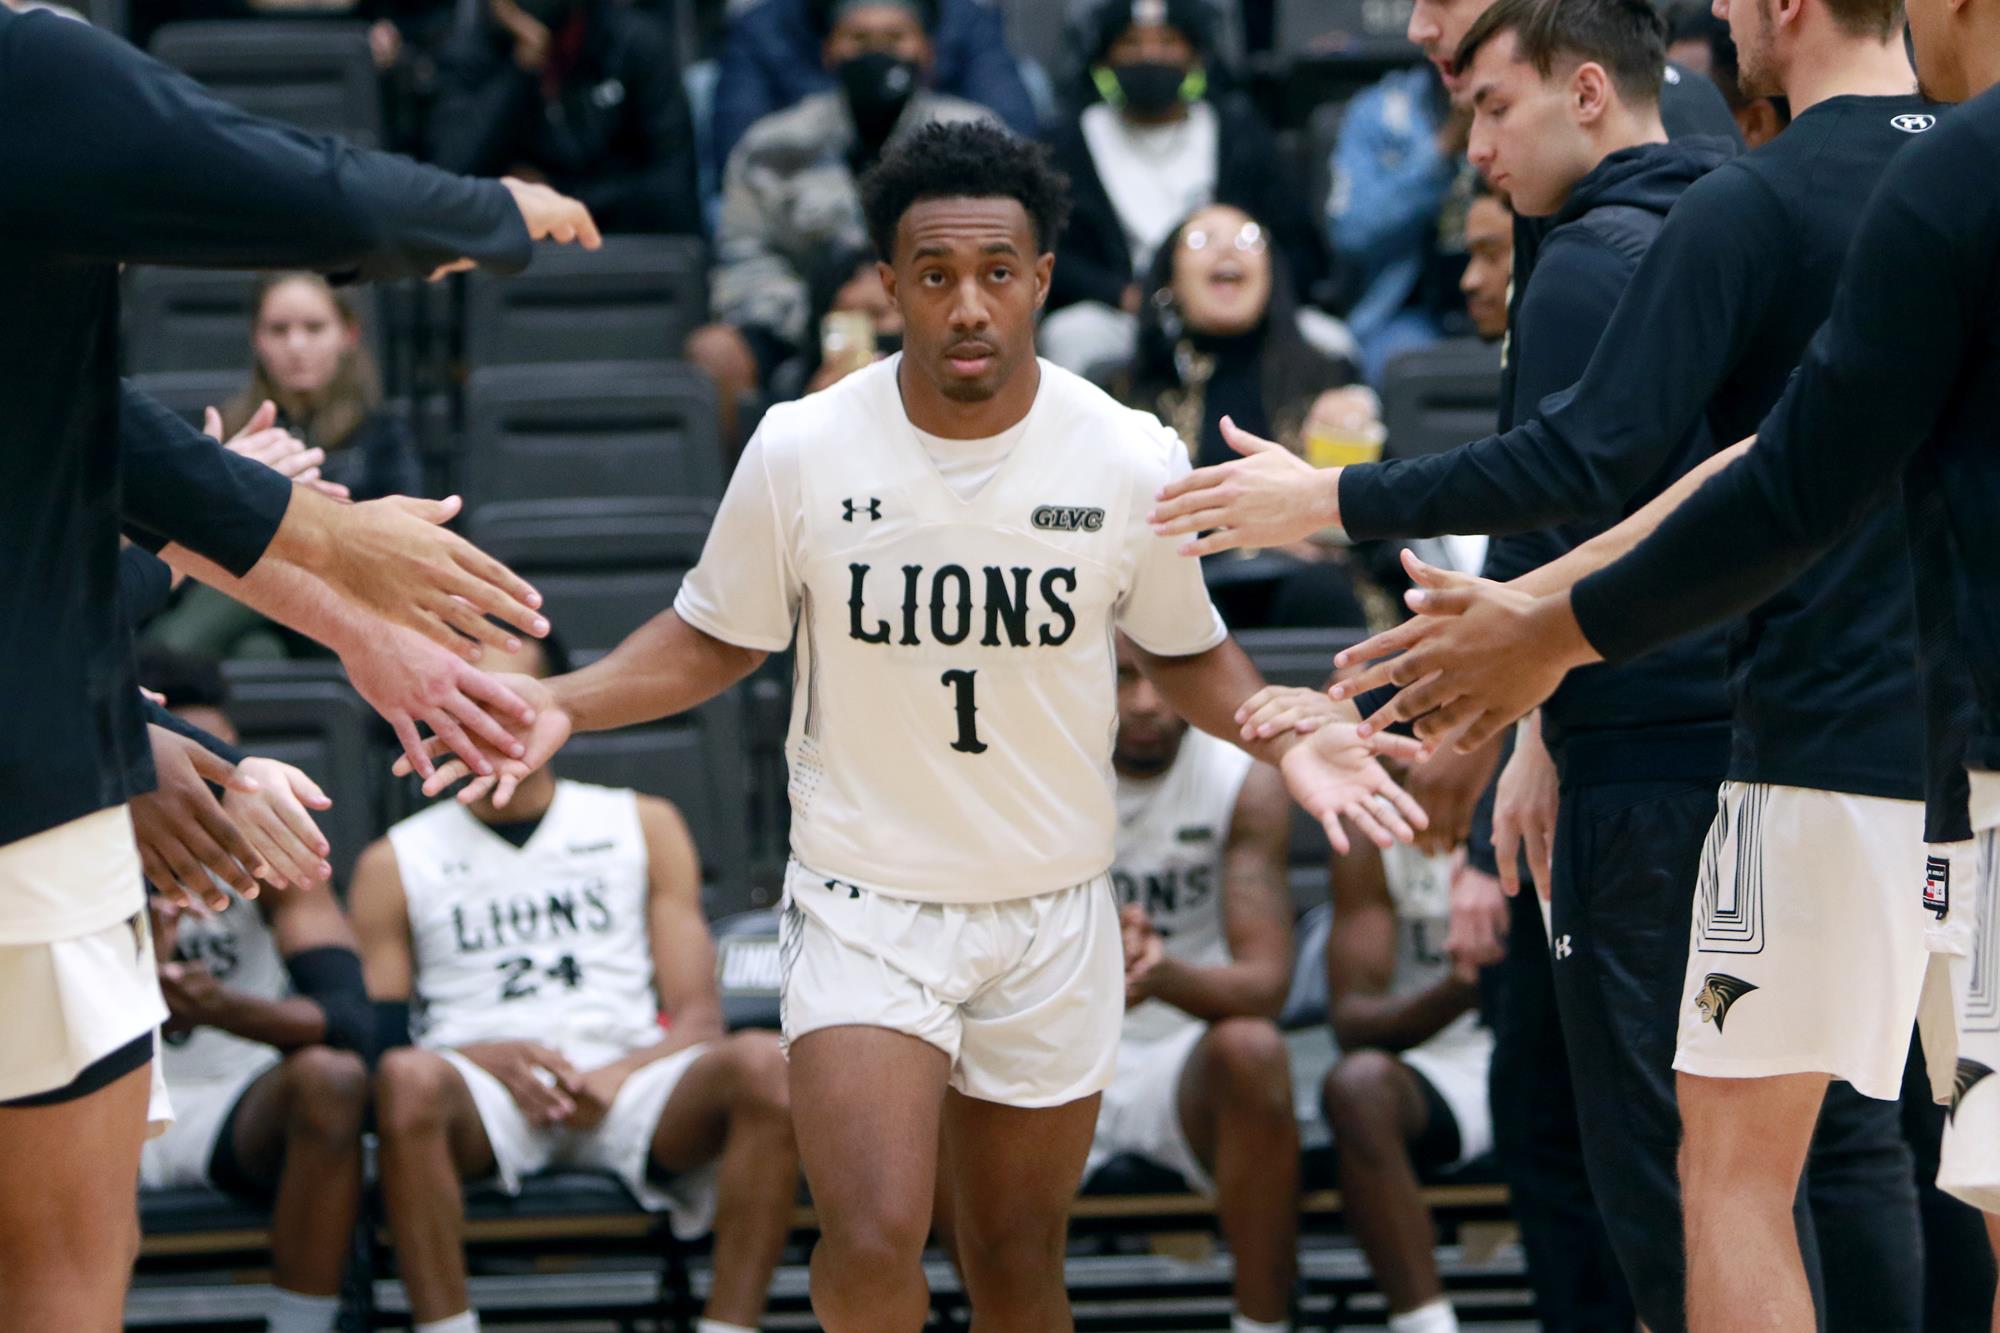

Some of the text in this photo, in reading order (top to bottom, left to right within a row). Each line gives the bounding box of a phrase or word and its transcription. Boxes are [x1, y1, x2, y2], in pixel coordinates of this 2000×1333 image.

[1031, 505, 1105, 532] GLVC
[848, 563, 1077, 647] LIONS
[941, 669, 987, 754] 1
[452, 877, 613, 953] LIONS
[497, 954, 582, 999] 24
